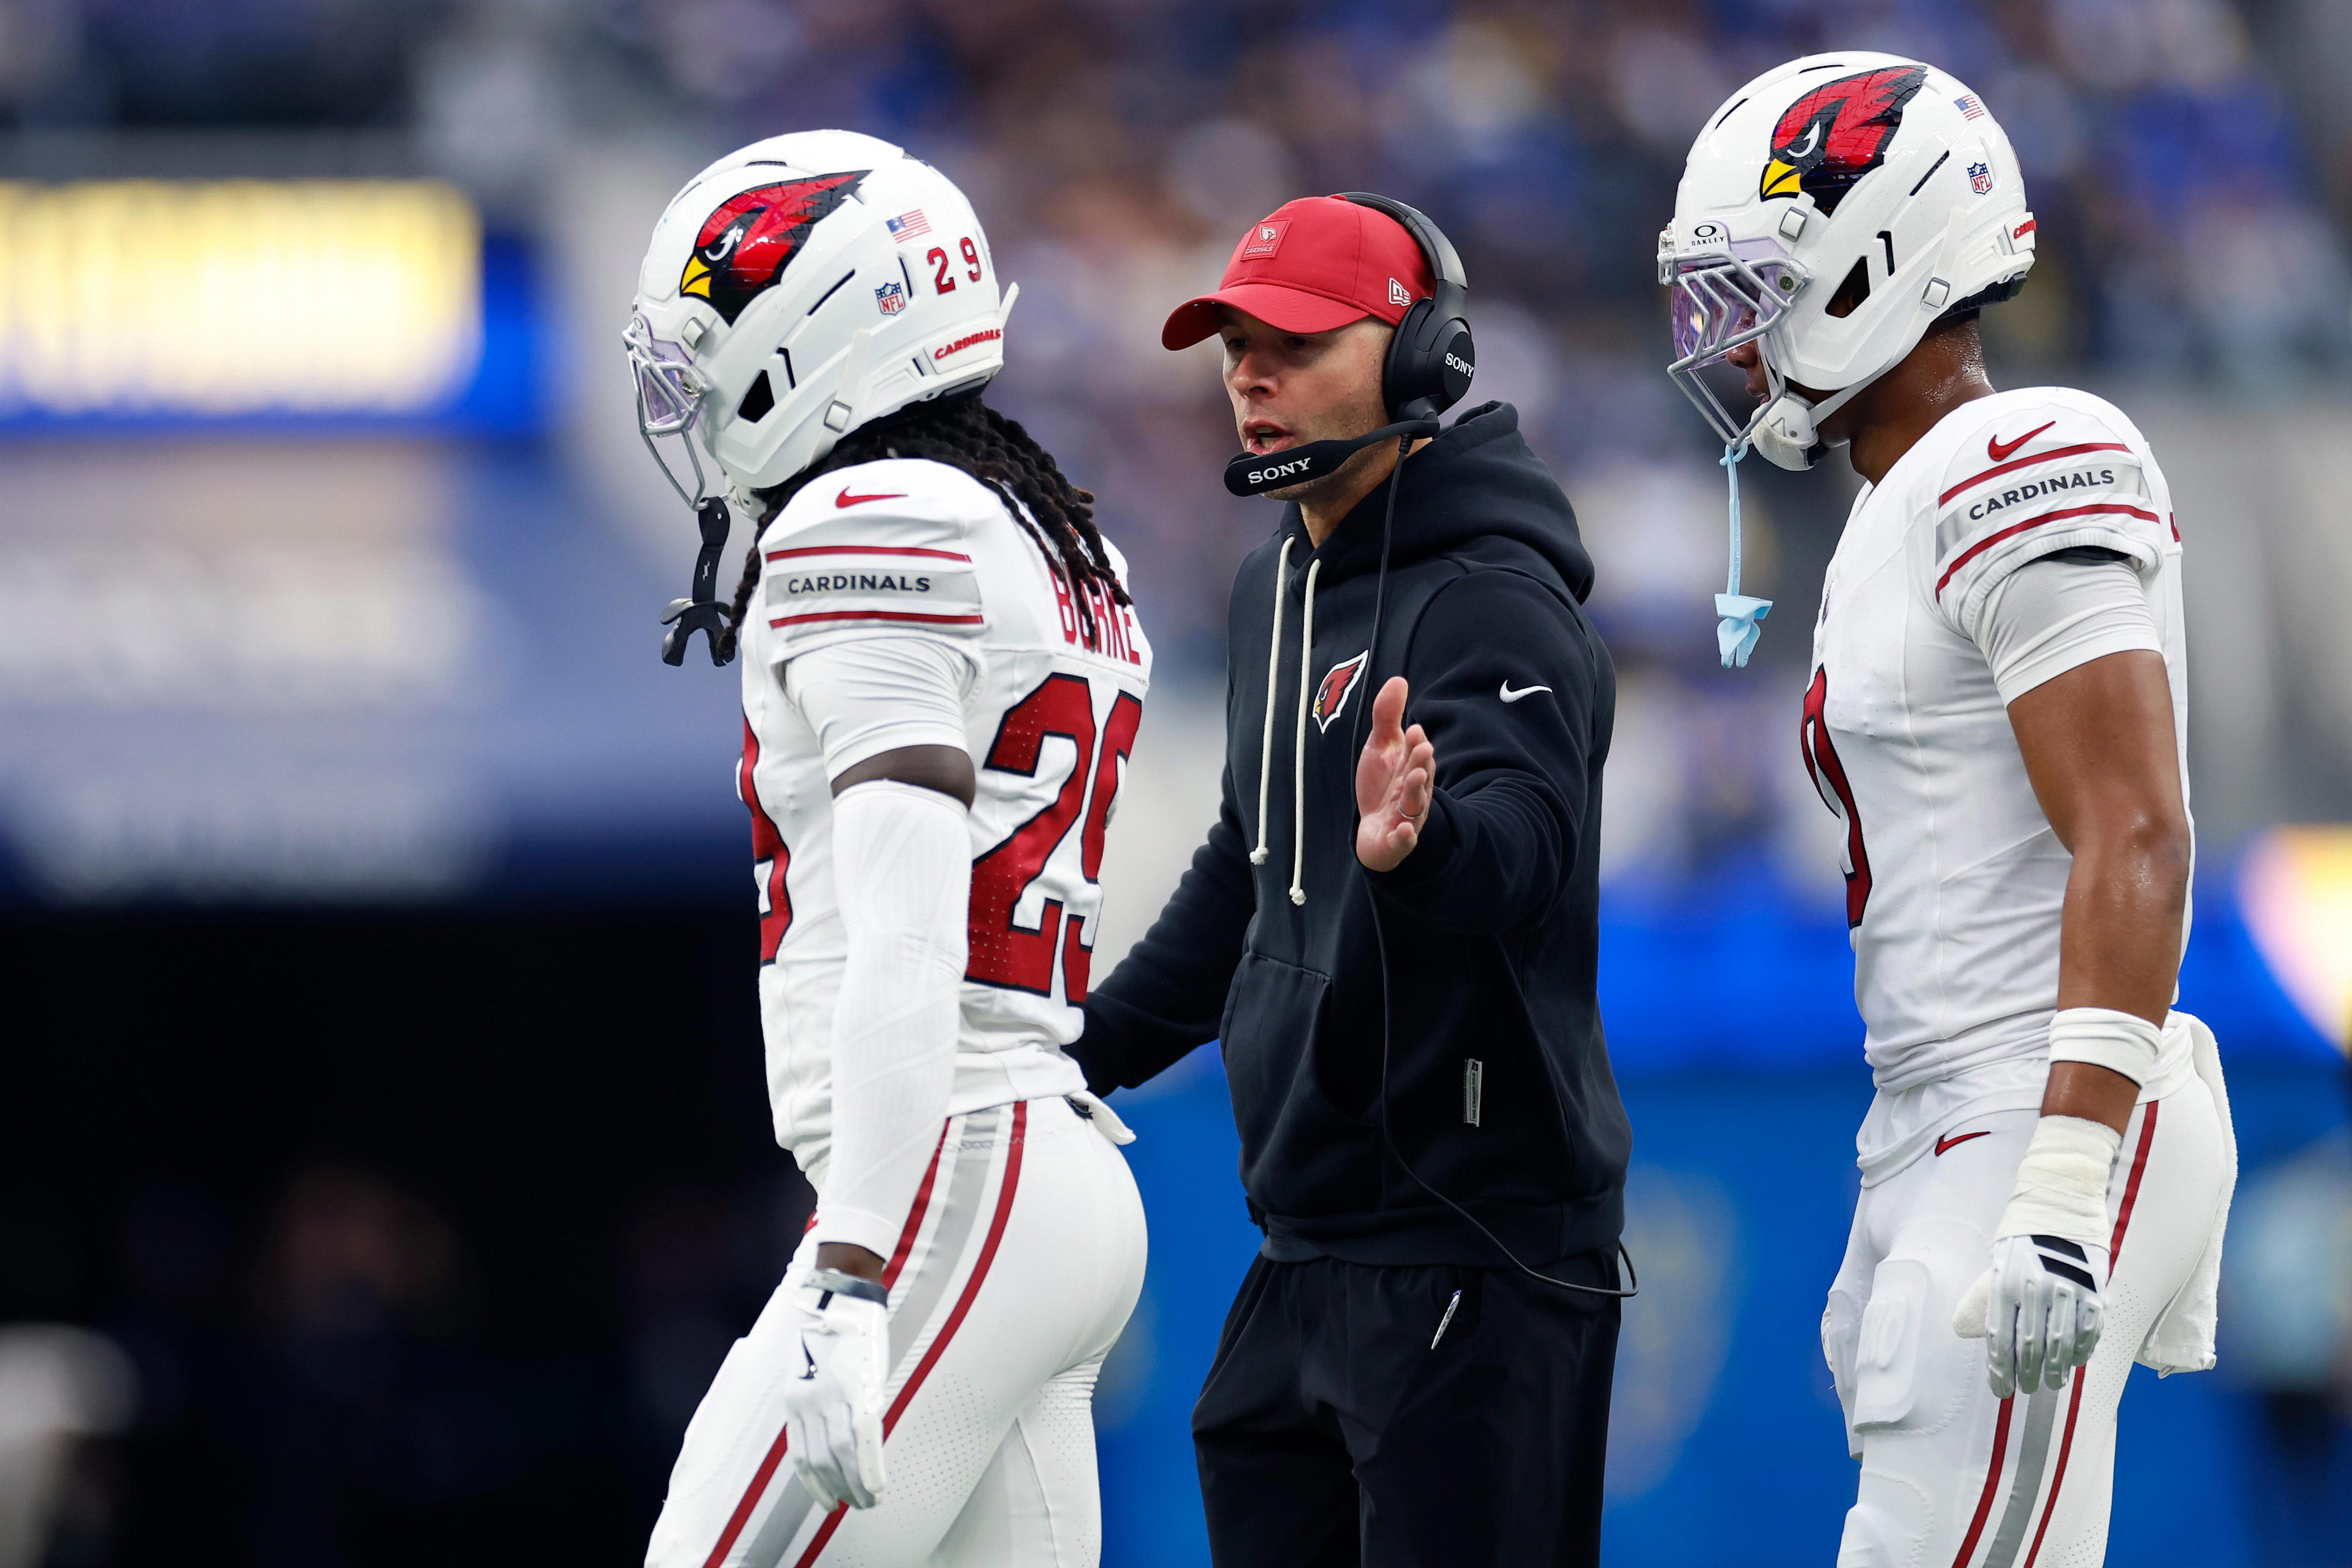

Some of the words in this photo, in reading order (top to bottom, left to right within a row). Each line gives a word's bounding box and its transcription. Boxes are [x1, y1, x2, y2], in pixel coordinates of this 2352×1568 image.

[1973, 174, 1990, 191] NFL
[1692, 237, 1725, 246] OAKLEY
[926, 237, 981, 295] 29
[880, 295, 904, 313] NFL
[934, 329, 1001, 360] CARDINALS
[1445, 352, 1475, 378] SONY
[1248, 457, 1311, 484] SONY
[1969, 470, 2115, 521] CARDINALS
[788, 575, 931, 594] CARDINALS
